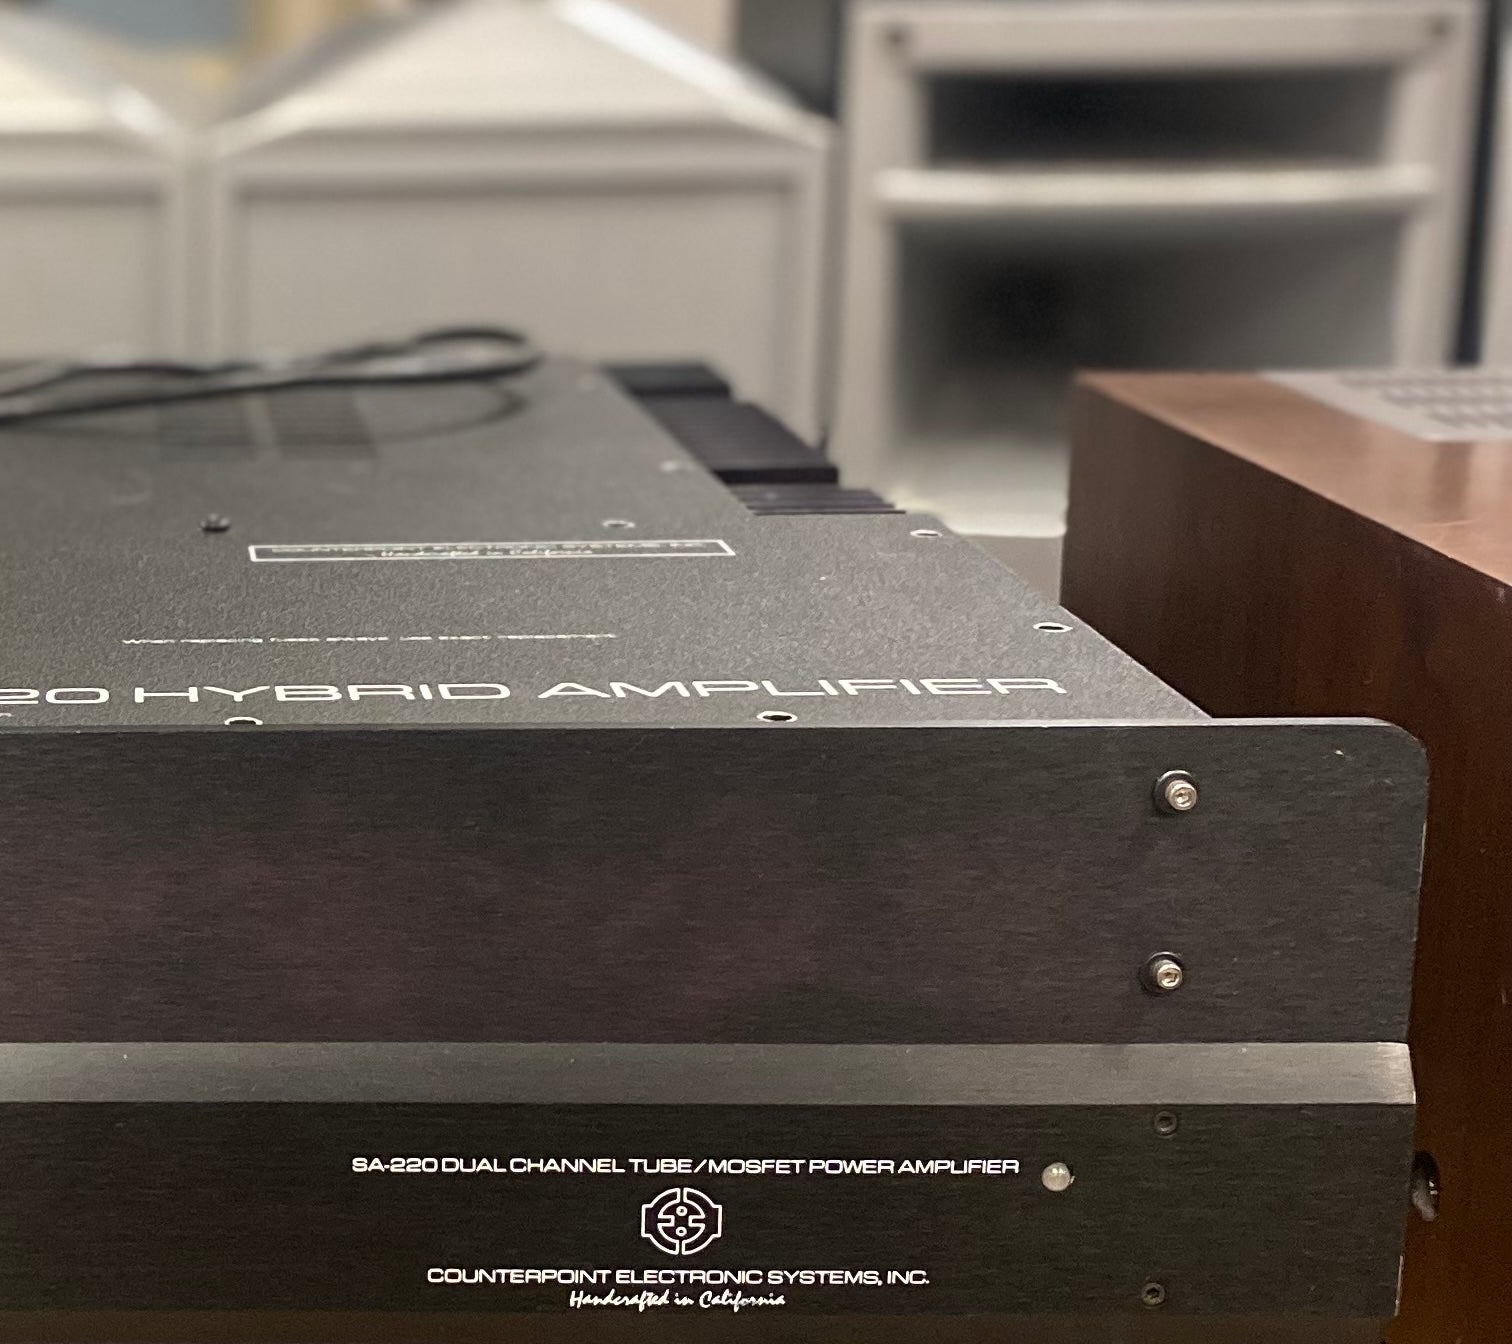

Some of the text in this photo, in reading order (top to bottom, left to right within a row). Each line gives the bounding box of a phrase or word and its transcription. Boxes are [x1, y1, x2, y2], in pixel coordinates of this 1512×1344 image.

[134, 683, 511, 704] HYBRID
[538, 678, 1068, 699] AMPLIFIER
[351, 1157, 1020, 1175] SA-220 DUAL CHANNEL TUBE/MOSFET POWER AMPLIFIER
[427, 1267, 930, 1287] COUNTERPOINT ELECTRONIC SYSTEMS, INC.
[569, 1289, 786, 1313] Handcrafted in California
